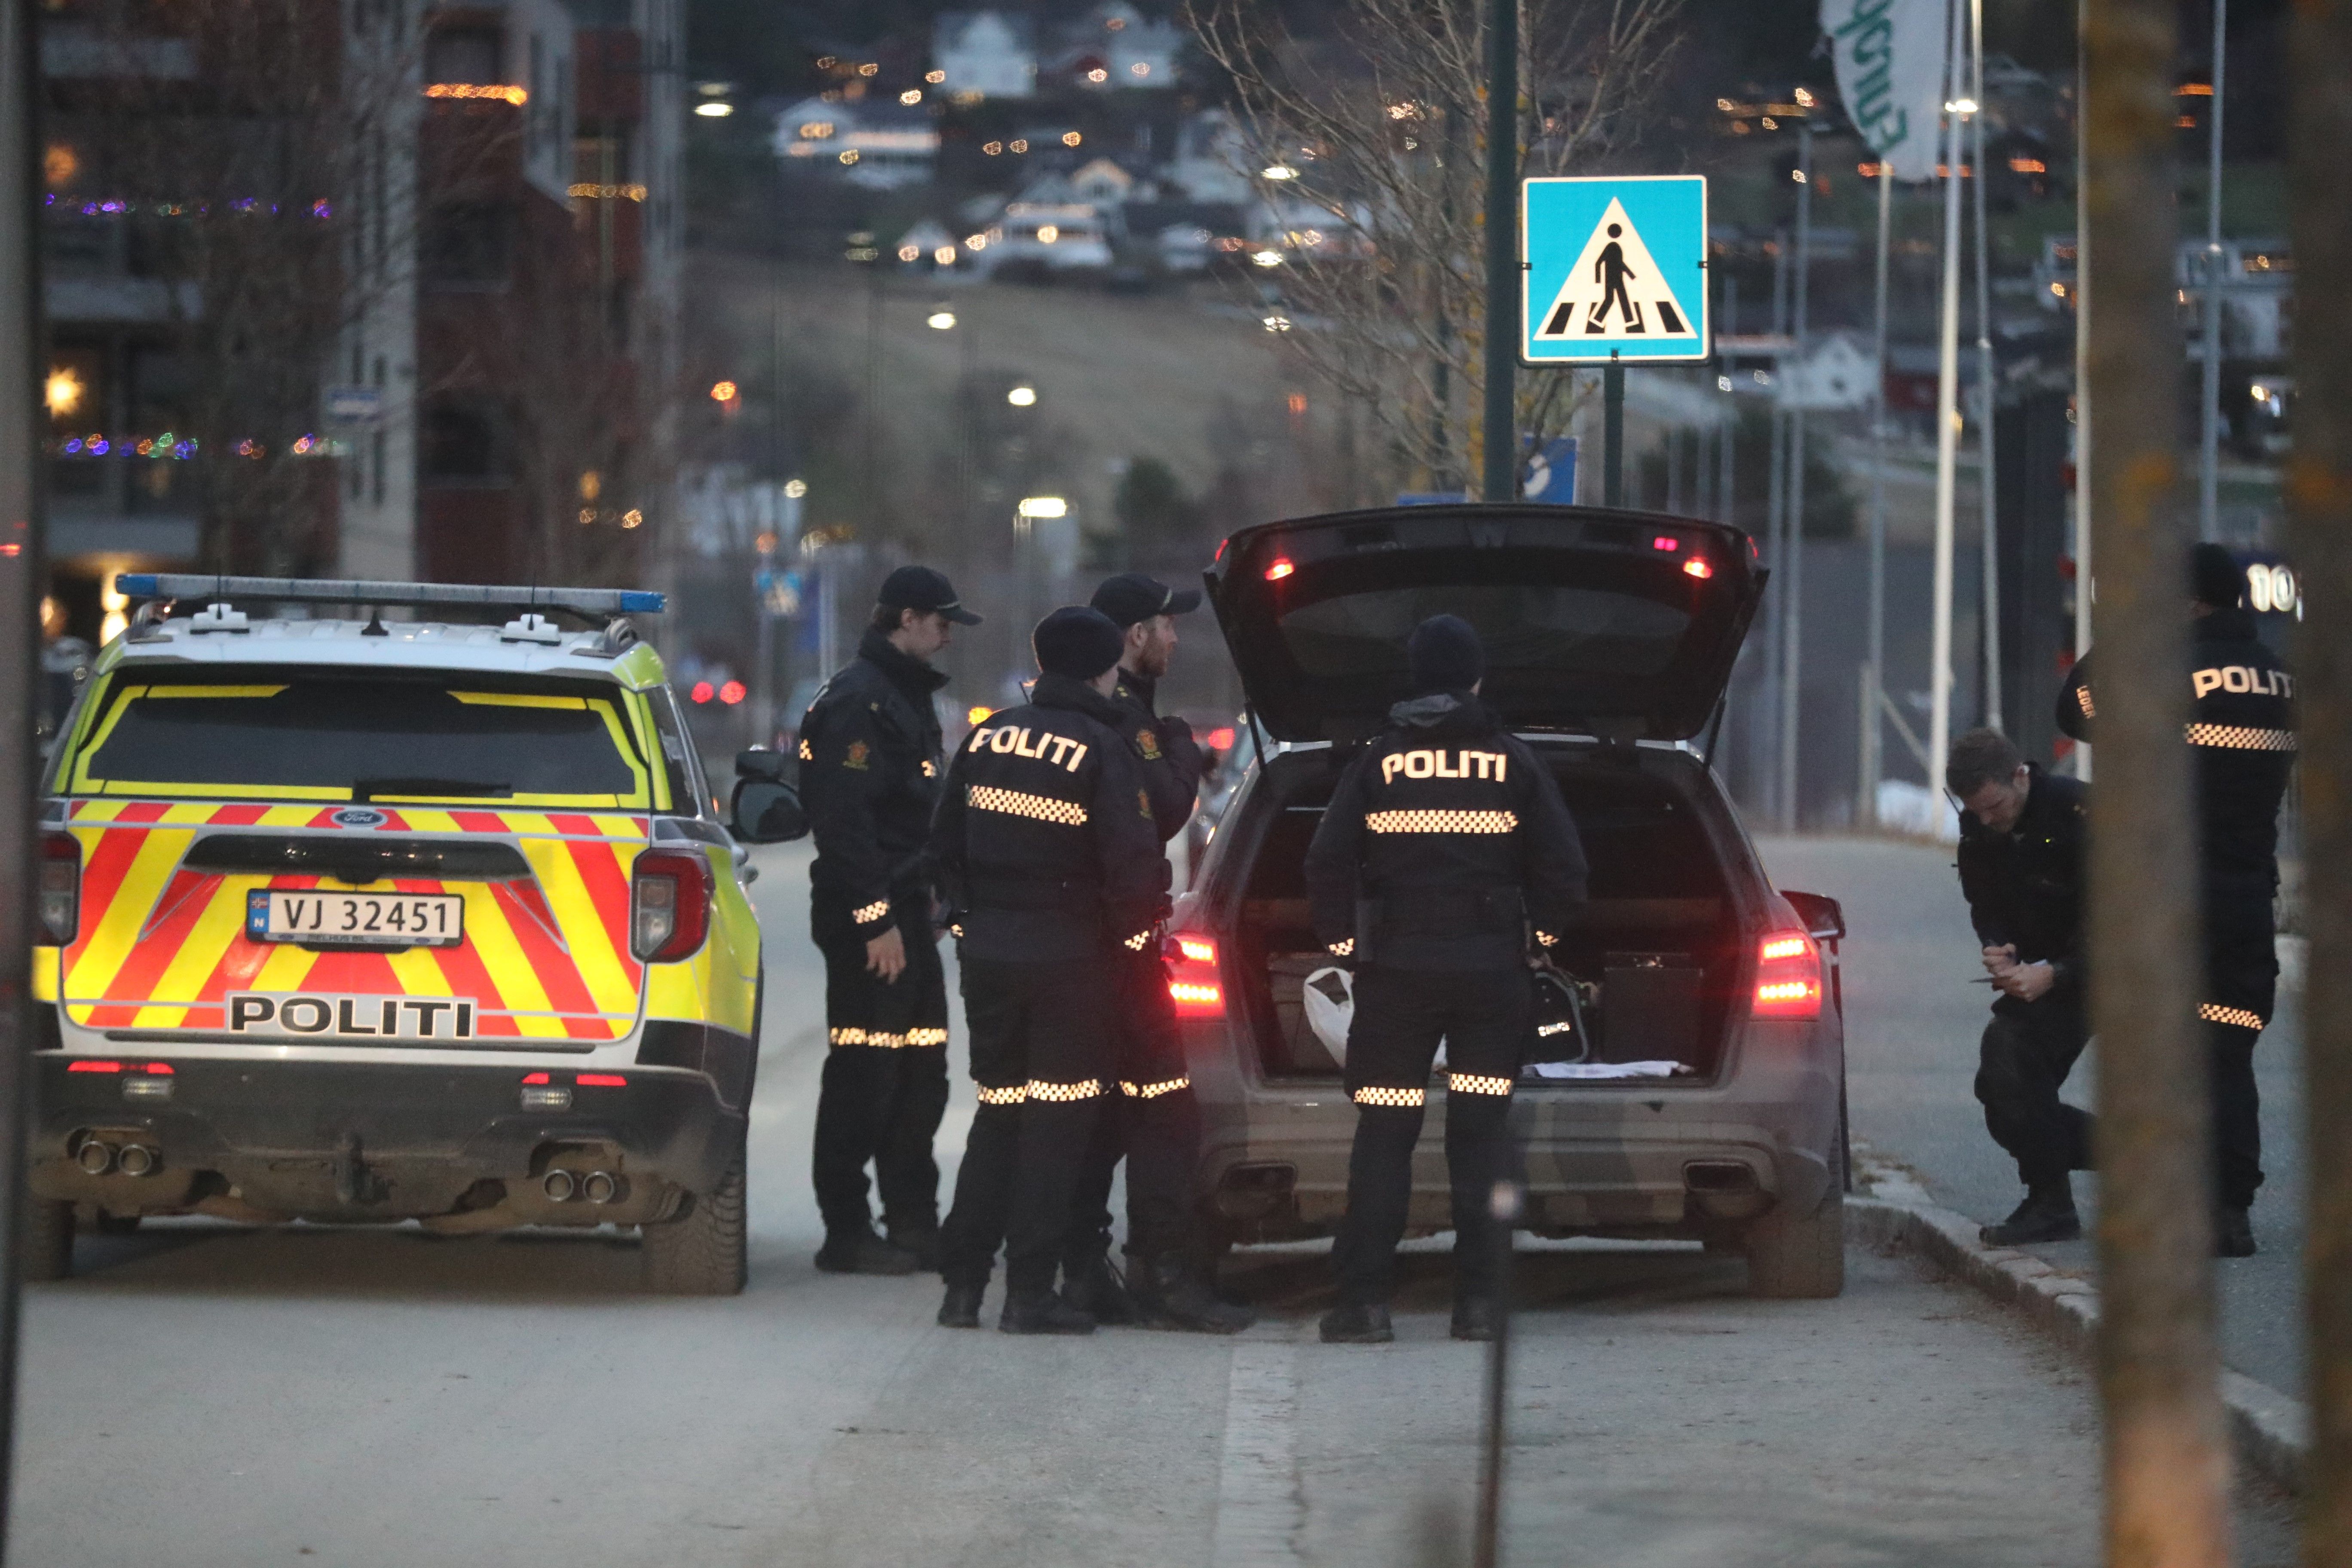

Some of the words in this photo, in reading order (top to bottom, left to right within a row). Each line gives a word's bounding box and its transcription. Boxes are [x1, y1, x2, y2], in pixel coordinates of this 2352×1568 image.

[968, 725, 1087, 772] POLITI
[1381, 749, 1507, 785] POLITI
[344, 812, 373, 822] Ford
[254, 918, 264, 928] N
[284, 899, 322, 930] VJ
[341, 900, 447, 933] 32451
[230, 995, 472, 1038] POLITI
